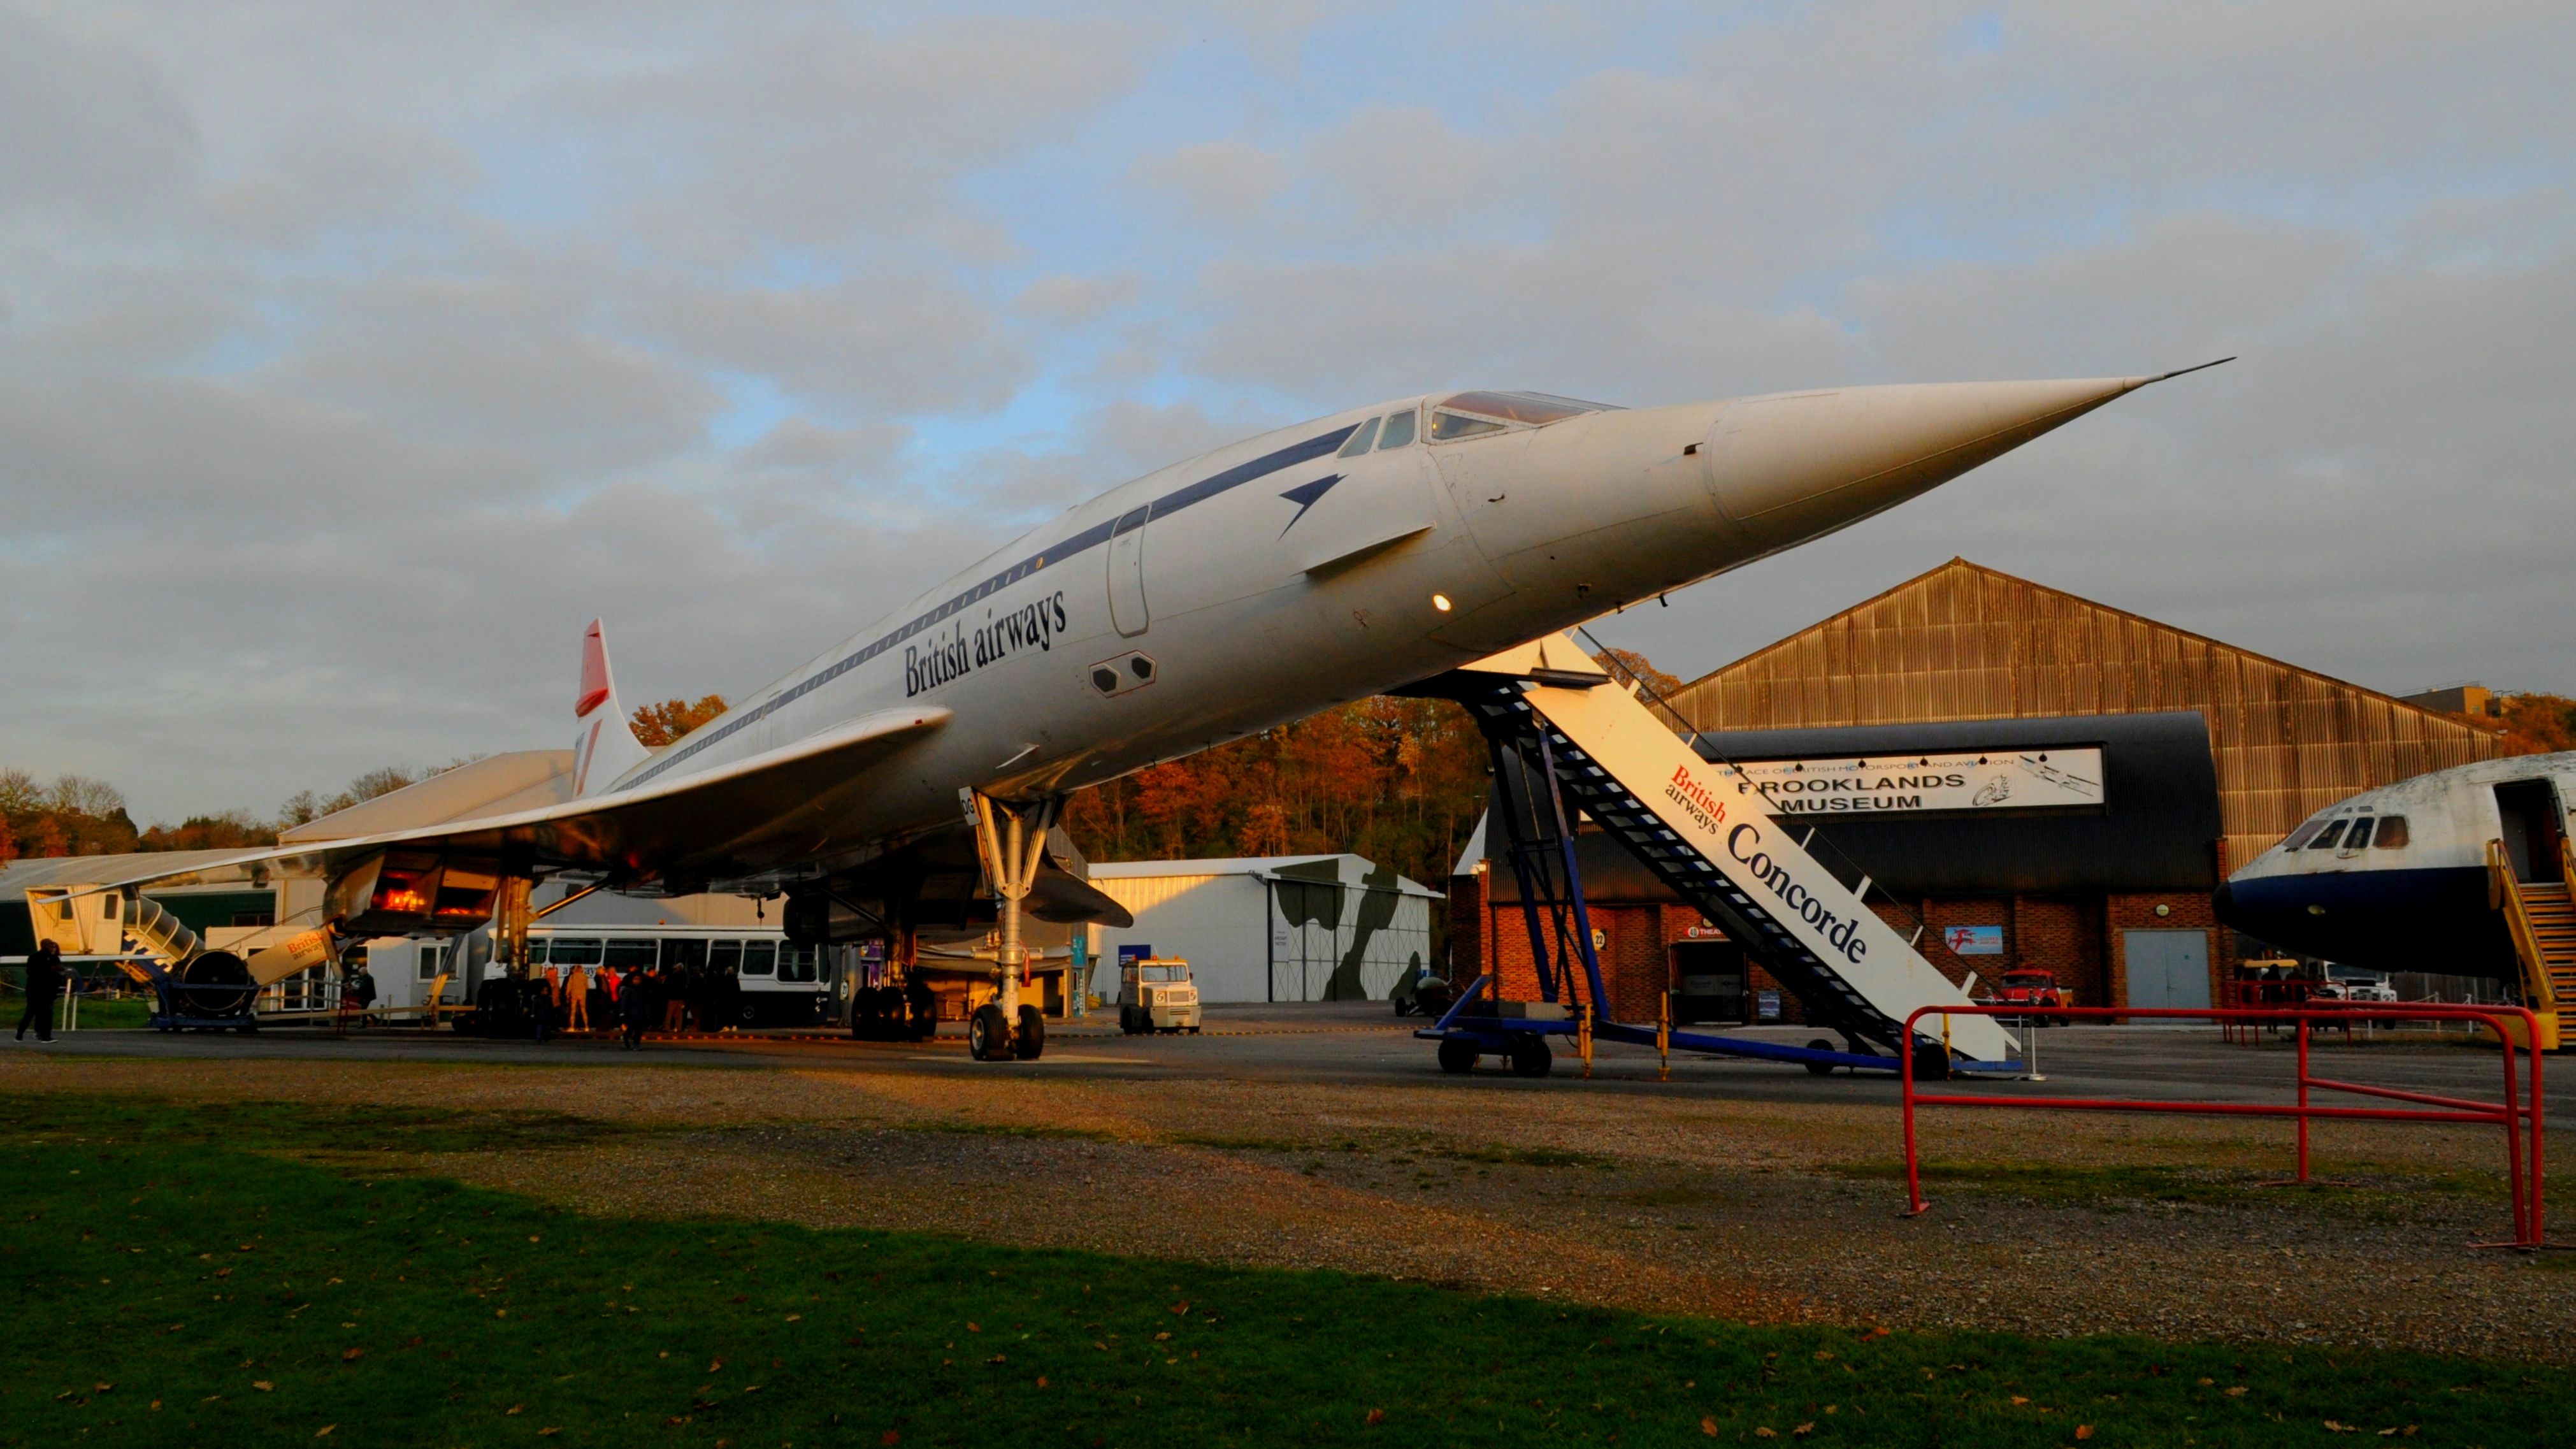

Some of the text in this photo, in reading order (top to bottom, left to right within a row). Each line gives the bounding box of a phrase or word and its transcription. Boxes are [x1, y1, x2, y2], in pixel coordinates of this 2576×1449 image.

[905, 591, 1066, 698] British airways
[1665, 784, 1719, 835] airways
[1671, 765, 1727, 823] British
[1781, 795, 1922, 813] MUSEUM
[1728, 823, 1866, 963] Concorde
[293, 943, 323, 960] airway
[1595, 935, 1603, 944] 22
